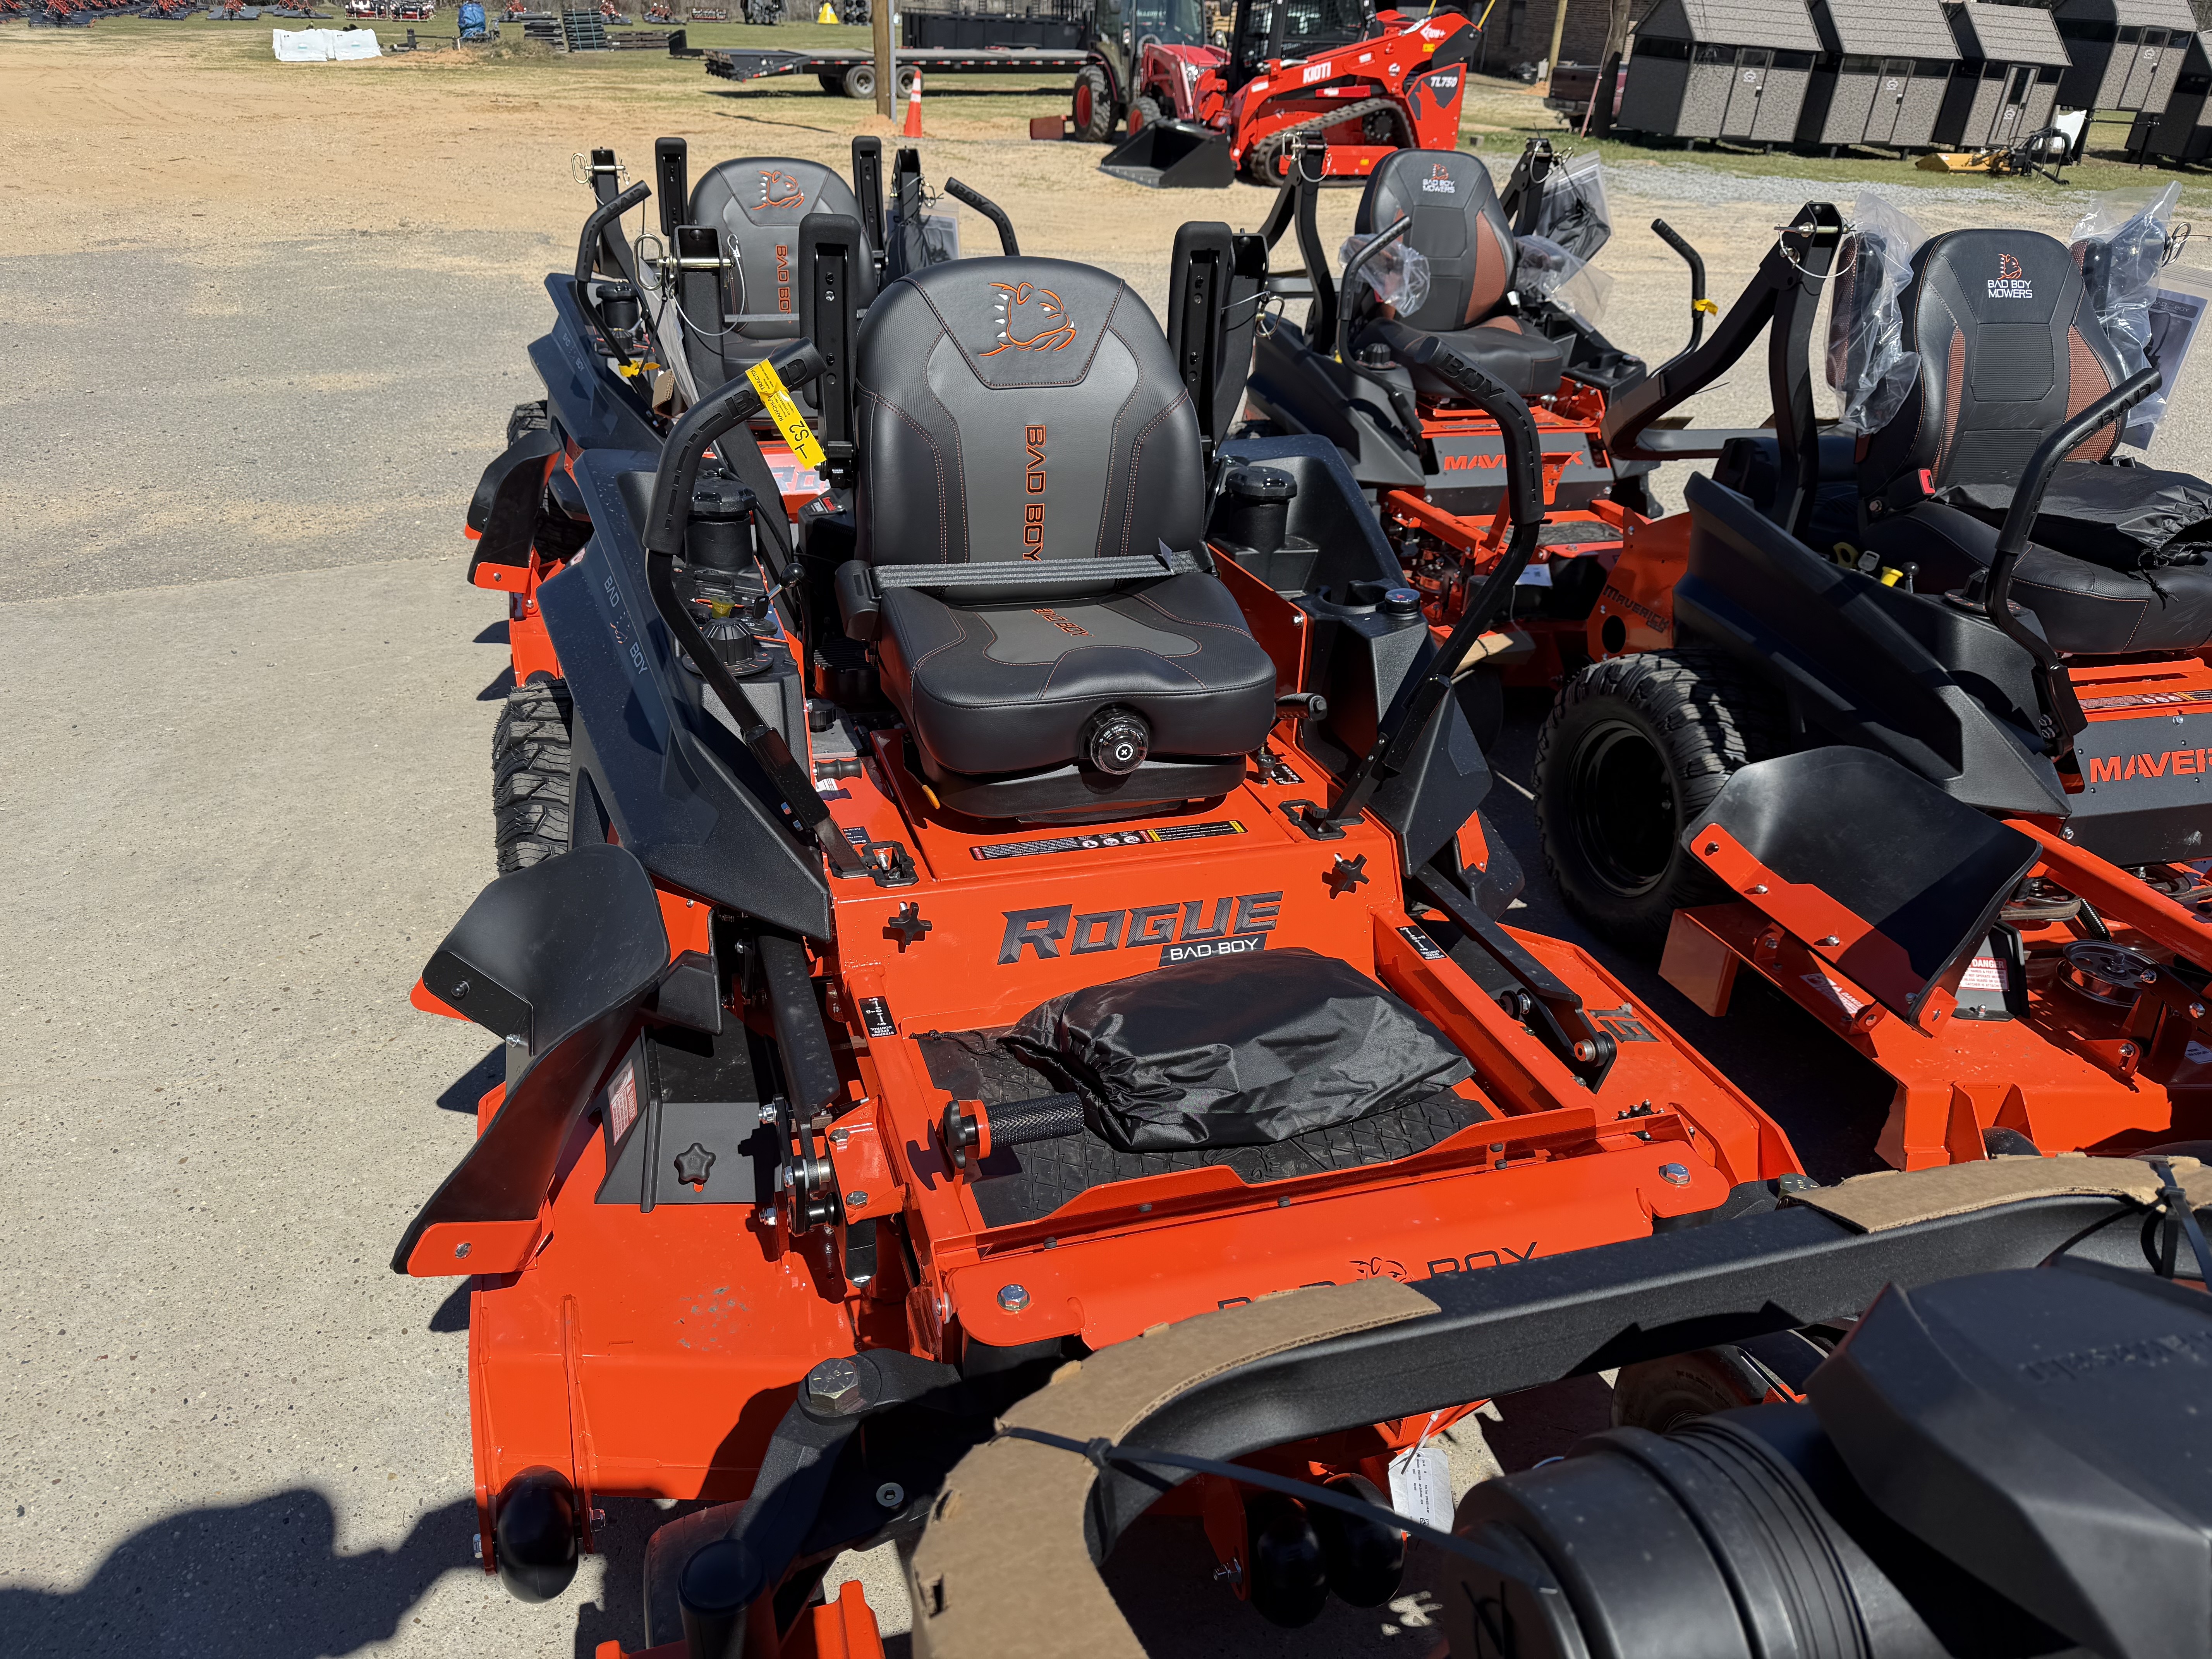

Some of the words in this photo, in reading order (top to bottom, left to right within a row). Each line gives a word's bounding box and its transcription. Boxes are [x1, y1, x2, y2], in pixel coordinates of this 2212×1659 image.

[1303, 61, 1331, 84] KIOTI
[1431, 76, 1458, 88] TL750
[776, 245, 789, 283] BAD
[1987, 280, 2009, 288] BAD
[2011, 280, 2032, 289] BOY
[1988, 289, 2033, 299] MOWERS
[778, 287, 791, 315] BO
[1436, 353, 1504, 401] BOY
[2097, 383, 2151, 429] BAD
[1024, 424, 1046, 495] BAD
[1022, 503, 1046, 561] BOY
[1603, 584, 1670, 629] MAVERICK
[604, 575, 620, 608] BAD
[629, 642, 648, 674] BOY
[1053, 622, 1096, 637] BOY
[997, 891, 1283, 965] ROGUE
[1170, 942, 1214, 960] BAD
[1217, 937, 1259, 955] BOY
[1972, 958, 2004, 968] DANGER
[627, 1090, 635, 1121] DANGER
